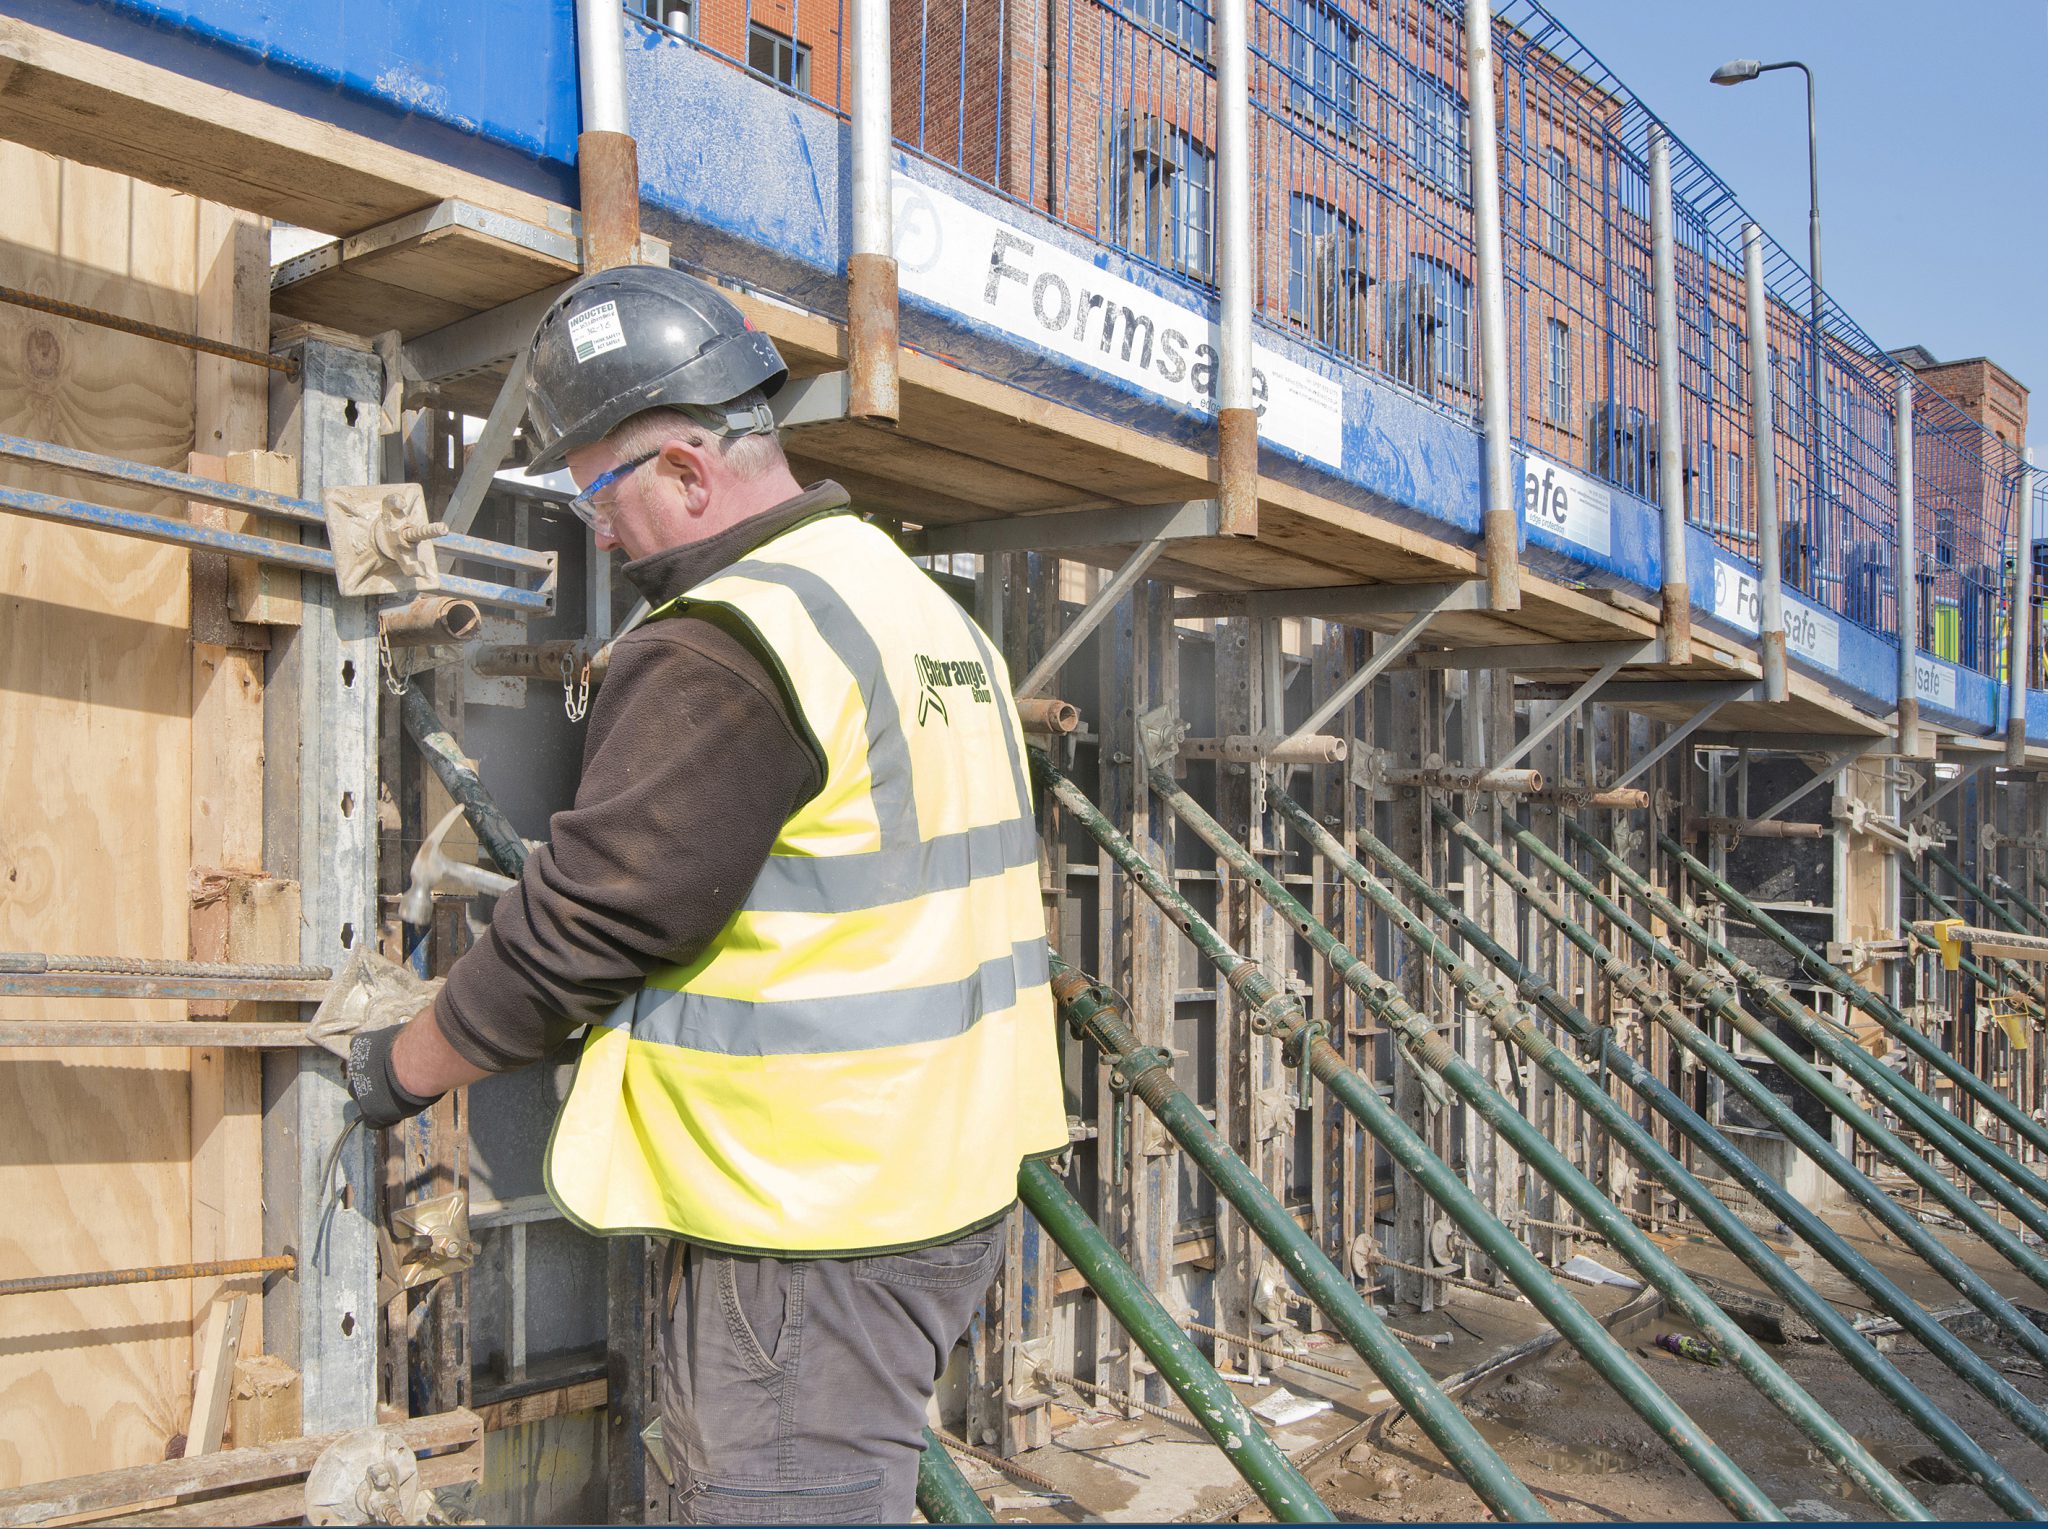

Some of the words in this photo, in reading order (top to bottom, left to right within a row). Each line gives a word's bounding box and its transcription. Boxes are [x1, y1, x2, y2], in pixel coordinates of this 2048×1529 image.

[570, 303, 614, 327] INDUCTED
[983, 228, 1269, 417] Formsae
[1737, 576, 1816, 650] Fosafe
